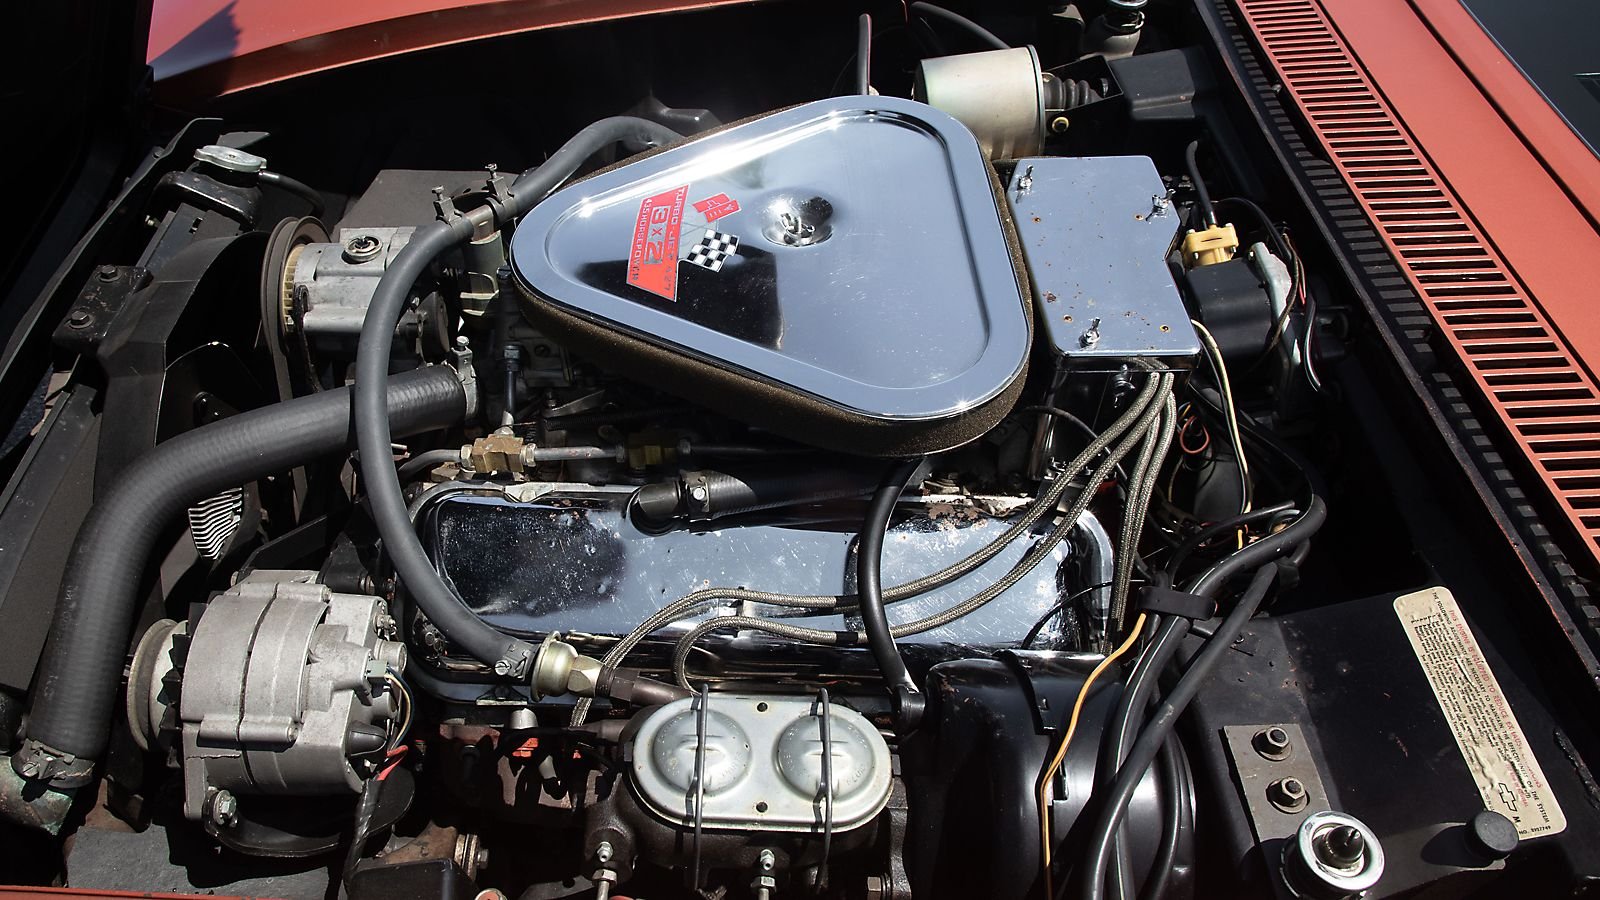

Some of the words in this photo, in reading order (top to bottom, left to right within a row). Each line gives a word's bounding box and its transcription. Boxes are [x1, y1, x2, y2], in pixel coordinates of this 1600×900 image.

[1437, 601, 1451, 624] FOLLOWING
[1450, 627, 1467, 655] ADJUSTMENTS
[1465, 658, 1473, 666] ARE
[1471, 668, 1486, 692] NECESSARY
[1489, 704, 1504, 728] MAINTAIN
[1531, 791, 1539, 800] THE
[1537, 804, 1549, 822] SYSTEM
[1488, 684, 1495, 693] TO
[1493, 695, 1508, 718] REDUCE
